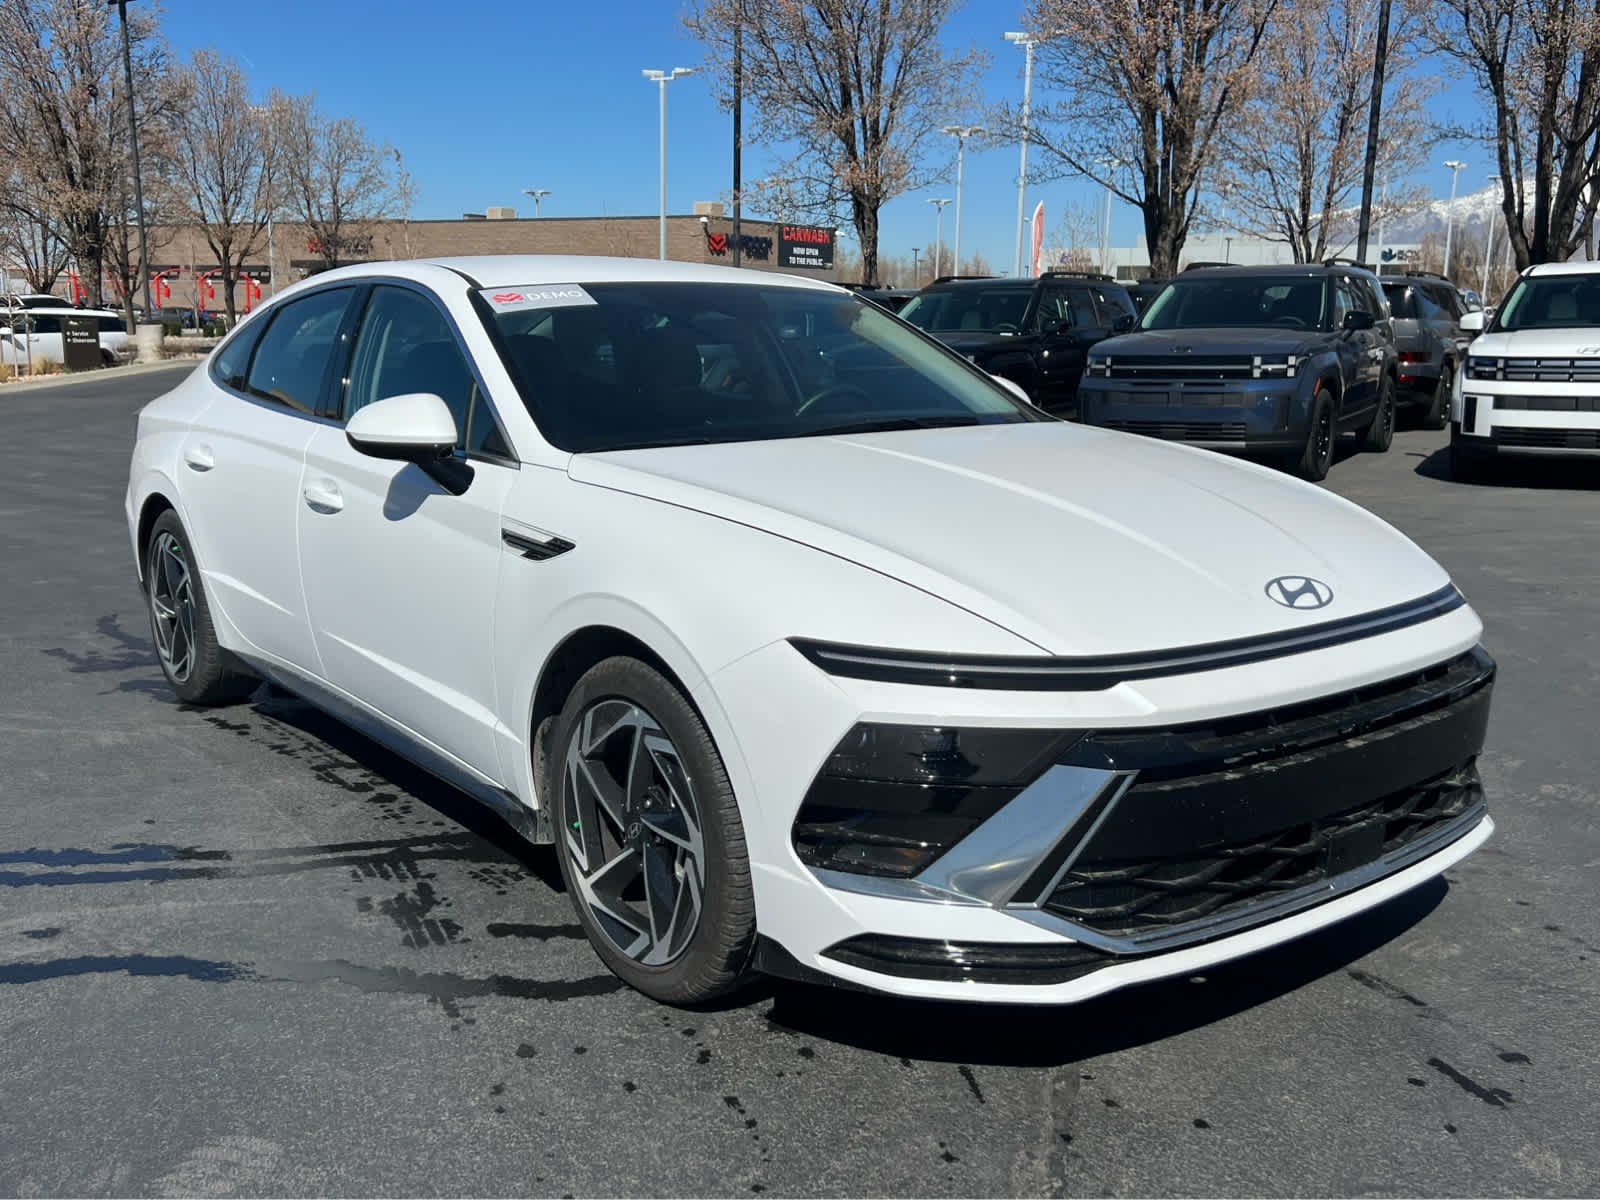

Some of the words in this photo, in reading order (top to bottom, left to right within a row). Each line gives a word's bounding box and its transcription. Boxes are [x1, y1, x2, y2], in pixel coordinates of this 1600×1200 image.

[782, 227, 830, 243] CARWASH
[793, 247, 805, 255] NOW
[806, 247, 819, 256] OPEN
[789, 256, 796, 264] TO
[526, 290, 582, 301] DEMO
